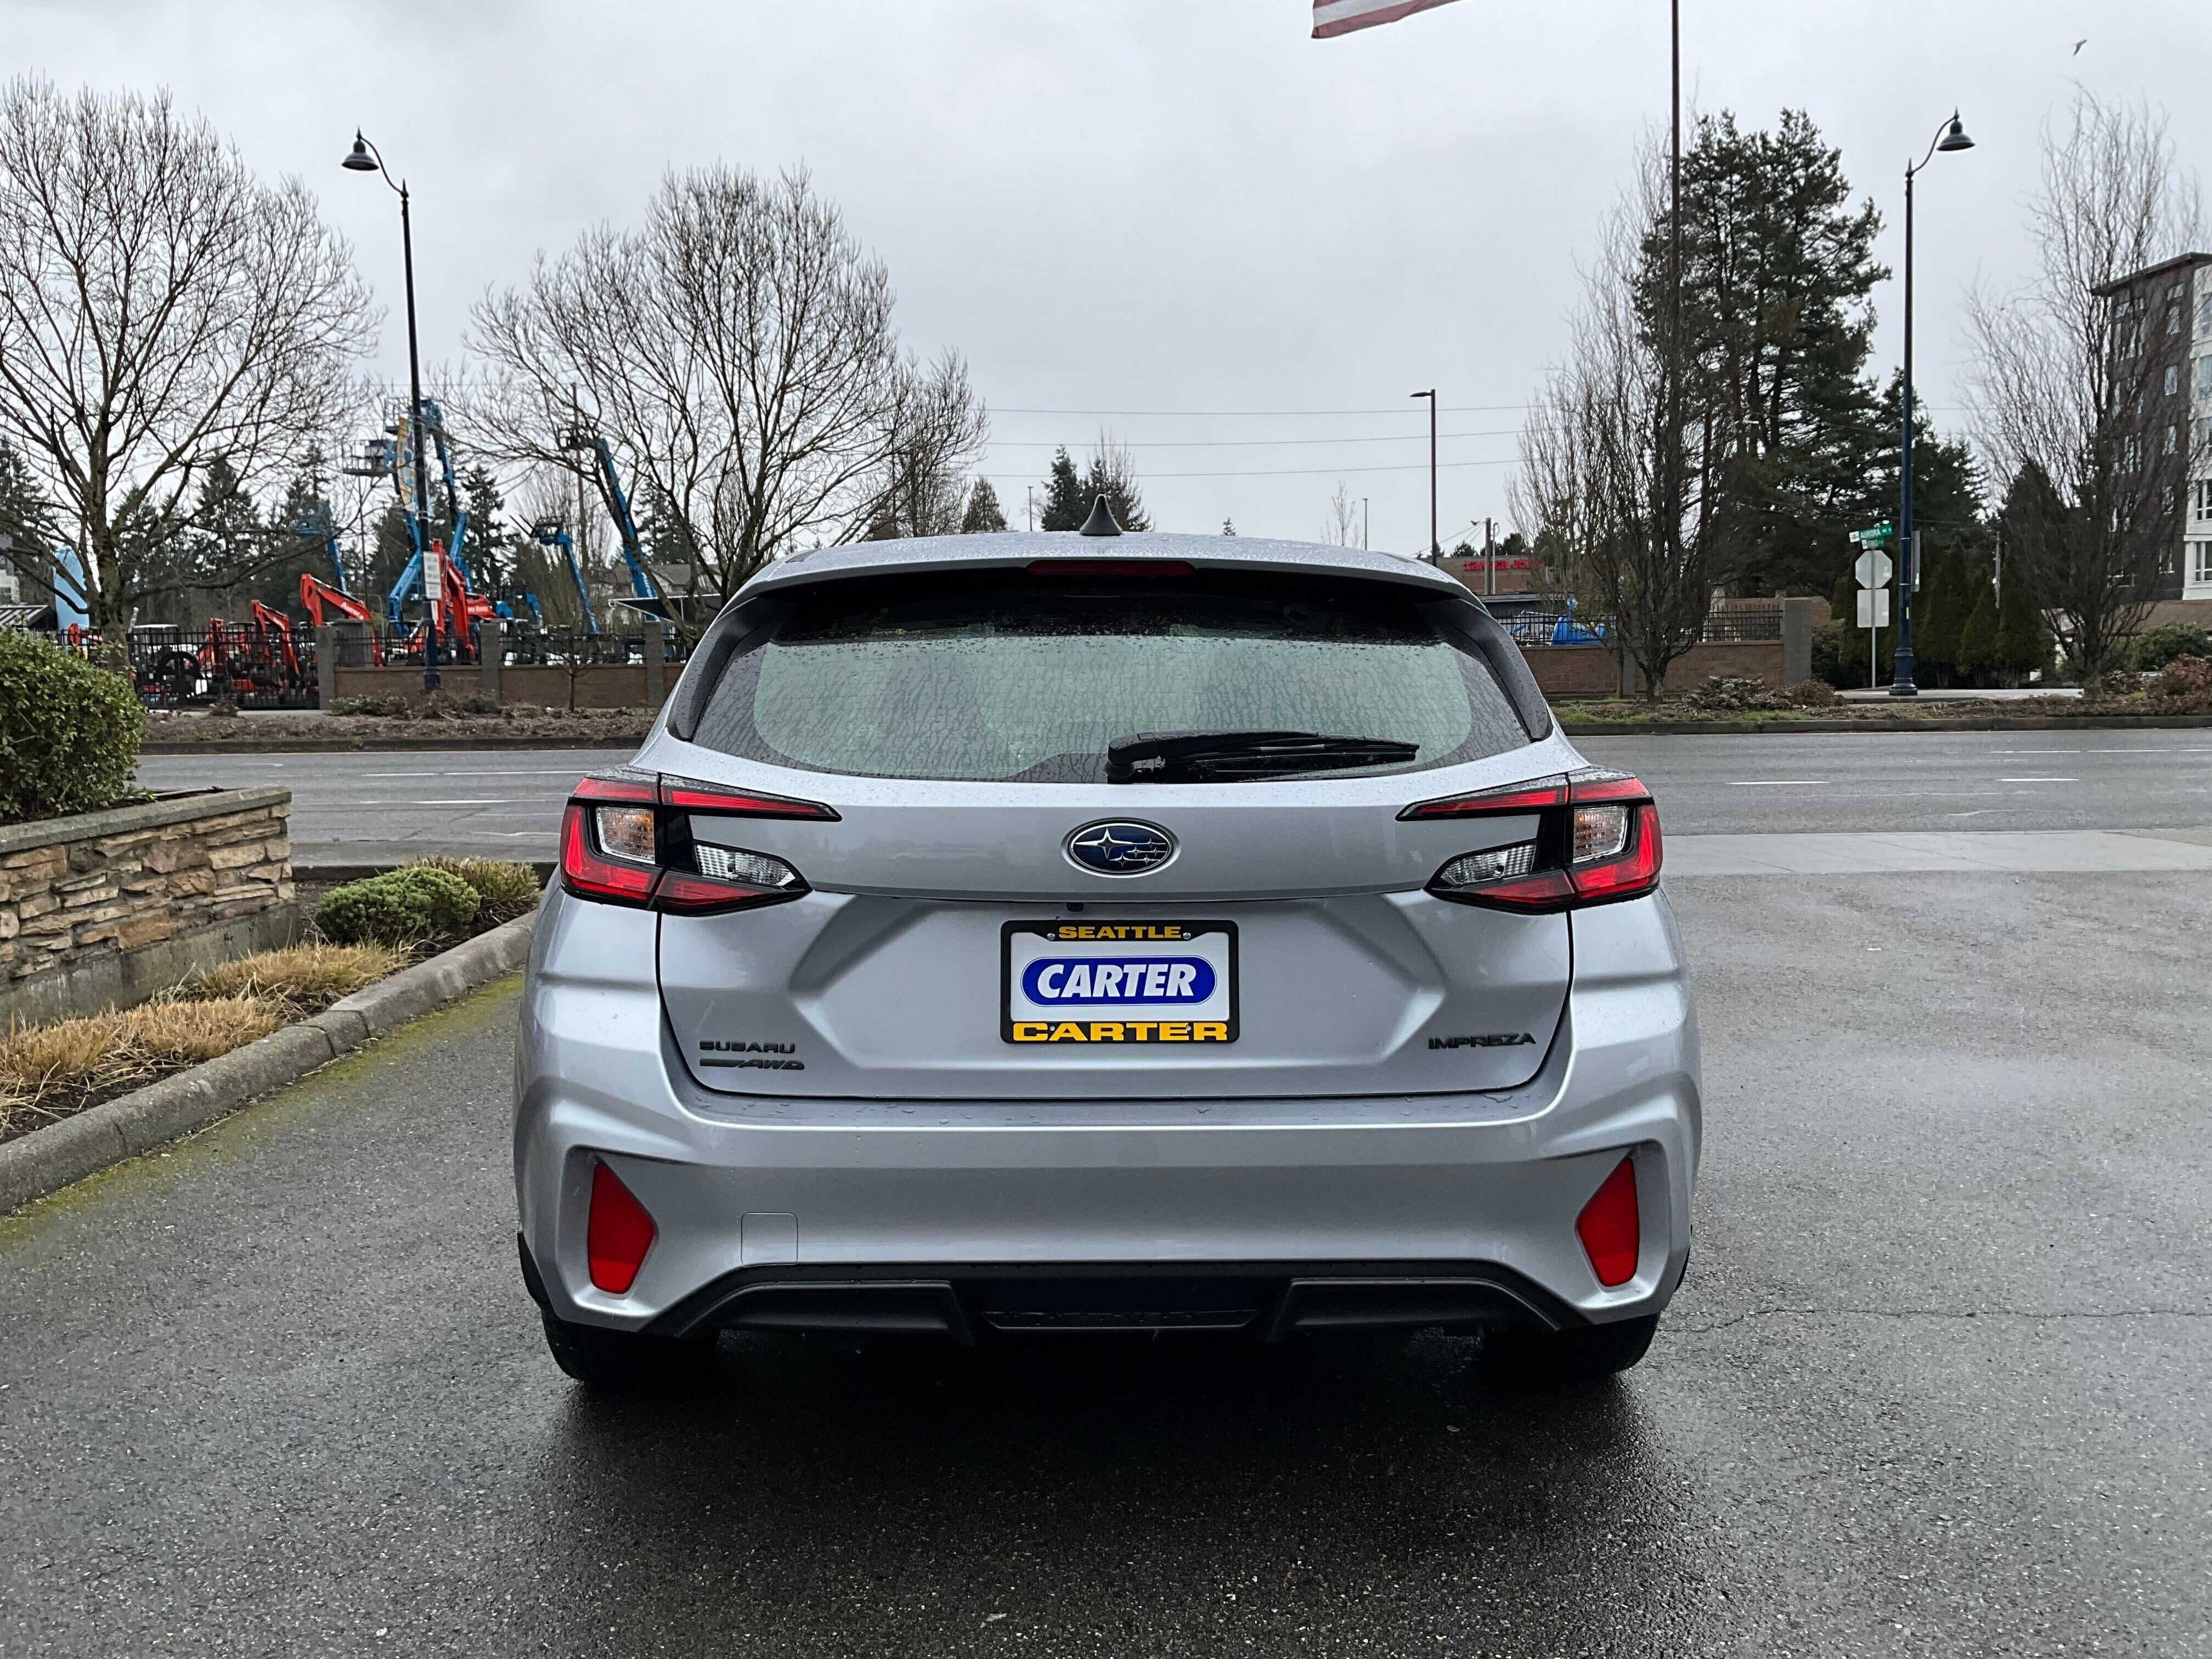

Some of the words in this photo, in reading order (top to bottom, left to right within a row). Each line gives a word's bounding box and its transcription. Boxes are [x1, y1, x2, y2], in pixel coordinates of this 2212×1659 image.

[1860, 528, 1881, 539] AURORA
[1058, 926, 1181, 939] SEATTLE
[1037, 963, 1197, 998] CARTER
[1013, 1022, 1228, 1041] CARTER
[699, 1040, 795, 1054] SUBARU
[1428, 1032, 1536, 1049] IMPREZA
[738, 1059, 805, 1070] AWD
